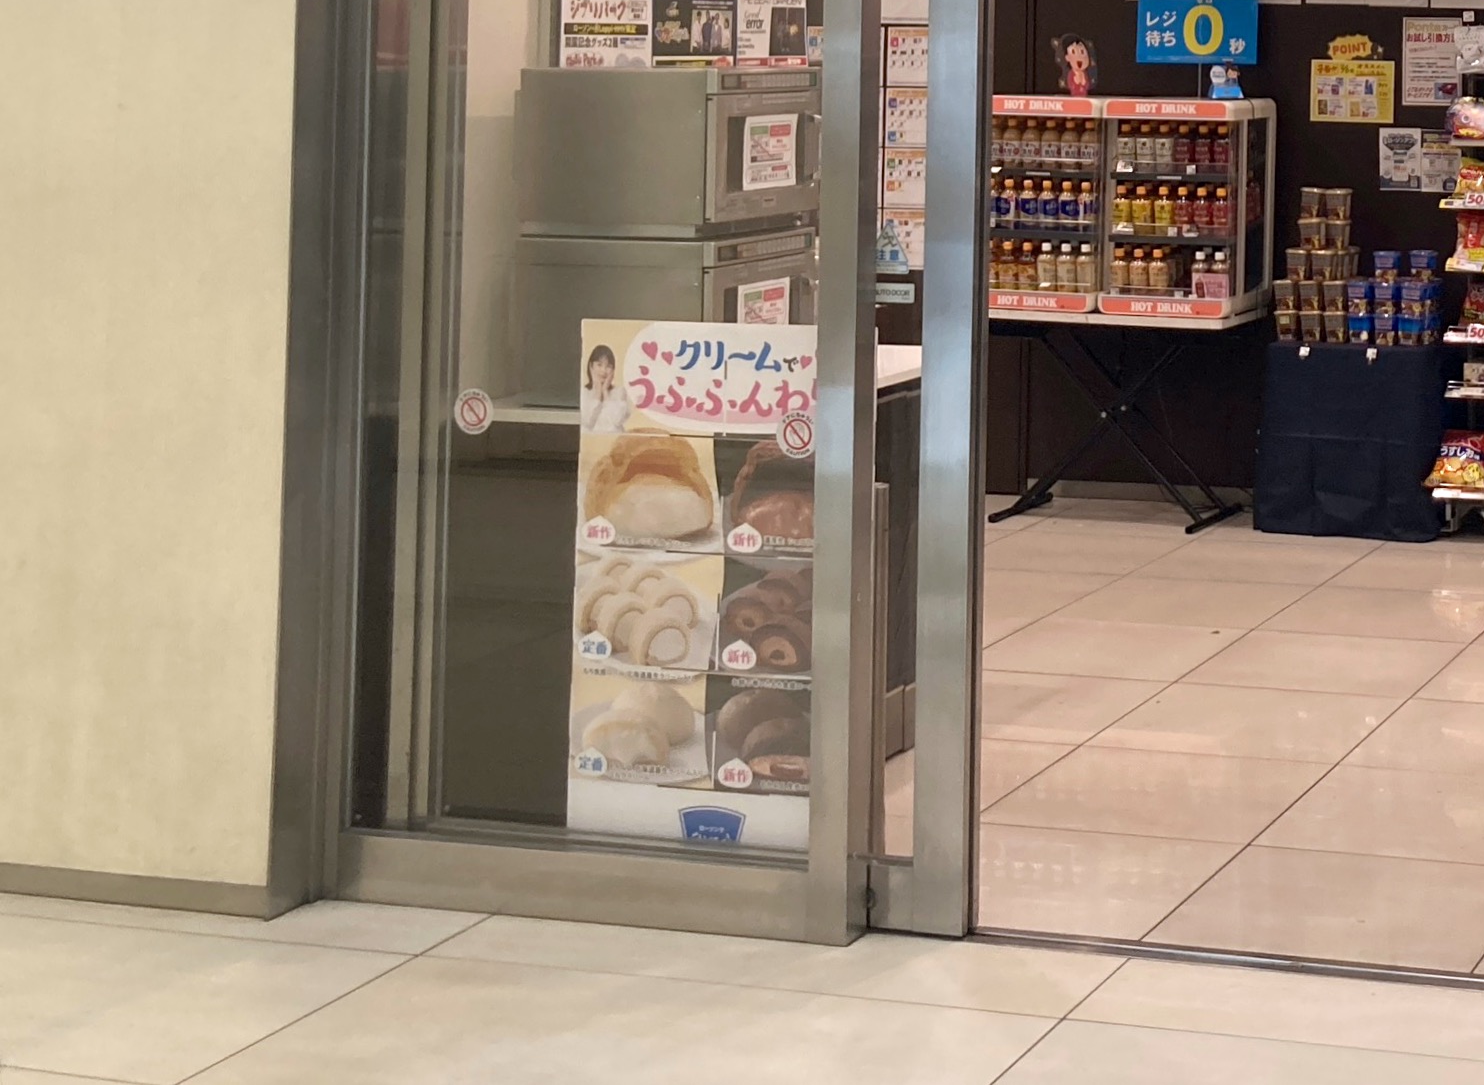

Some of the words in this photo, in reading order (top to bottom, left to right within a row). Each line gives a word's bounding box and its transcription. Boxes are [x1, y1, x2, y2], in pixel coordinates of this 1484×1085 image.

[1145, 10, 1178, 28] レジ
[1183, 4, 1224, 56] 0
[1229, 37, 1246, 55] 秒
[1145, 30, 1177, 48] 待ち
[1332, 41, 1368, 56] POINT
[1003, 99, 1027, 110] HOT
[1028, 100, 1064, 112] DRINK
[1135, 102, 1159, 114] HOT
[1160, 103, 1197, 115] DRINK
[1467, 194, 1484, 205] 50
[997, 294, 1021, 306] HOT
[1022, 295, 1058, 307] DRINK
[1130, 300, 1154, 312] HOT
[1156, 301, 1193, 313] DRINK
[675, 339, 799, 373] クリームで
[586, 525, 613, 540] 新作
[732, 533, 759, 548] 新作
[581, 639, 608, 655] 定番
[726, 649, 752, 665] 新作
[578, 756, 604, 772] 定番
[722, 768, 749, 783] 新作
